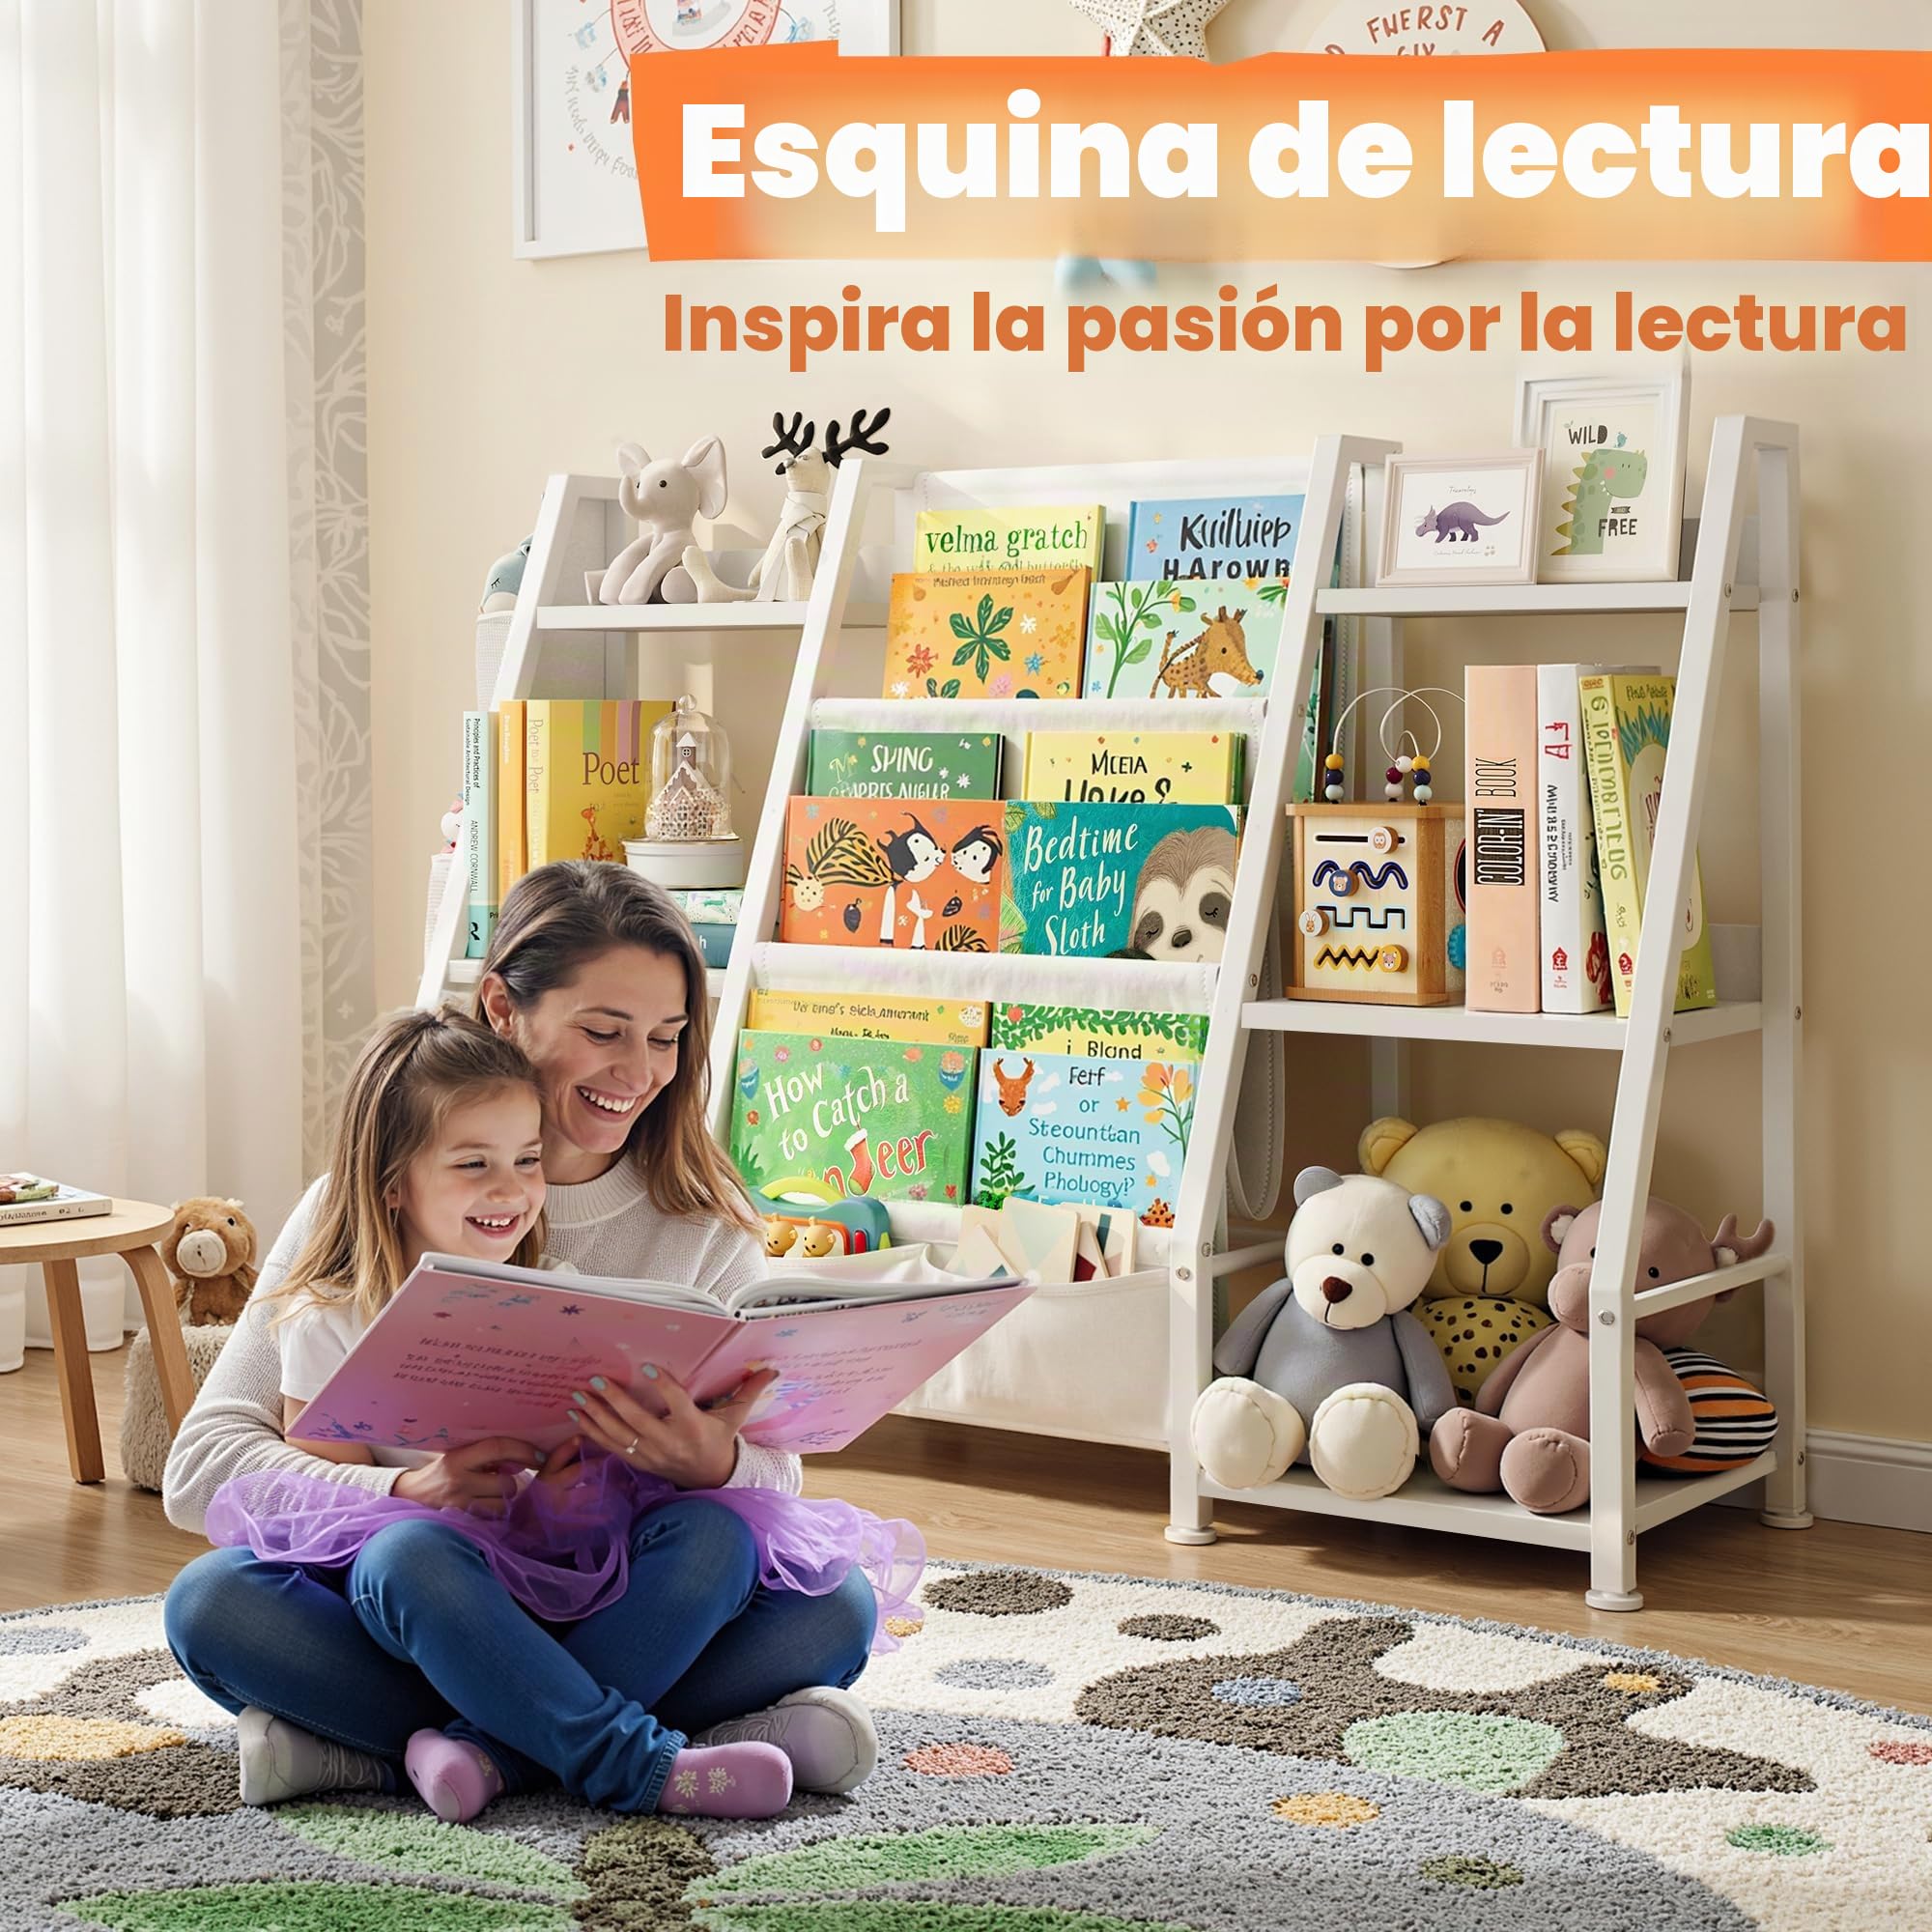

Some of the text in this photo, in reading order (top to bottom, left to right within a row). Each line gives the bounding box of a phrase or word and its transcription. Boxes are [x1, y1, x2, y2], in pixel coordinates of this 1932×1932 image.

[1568, 425, 1607, 444] WILD
[924, 521, 1088, 557] velma gratch
[1598, 519, 1637, 537] FREE
[582, 752, 640, 785] Poet
[1475, 757, 1518, 798] BOOK
[469, 819, 479, 894] ANDREW CORNWALL
[1024, 815, 1139, 874] Bedtime
[1032, 860, 1126, 917] for Baby
[1044, 909, 1106, 956] Sloth
[763, 1062, 823, 1122] How
[778, 1065, 910, 1161] to Catch a
[1079, 1099, 1100, 1113] or
